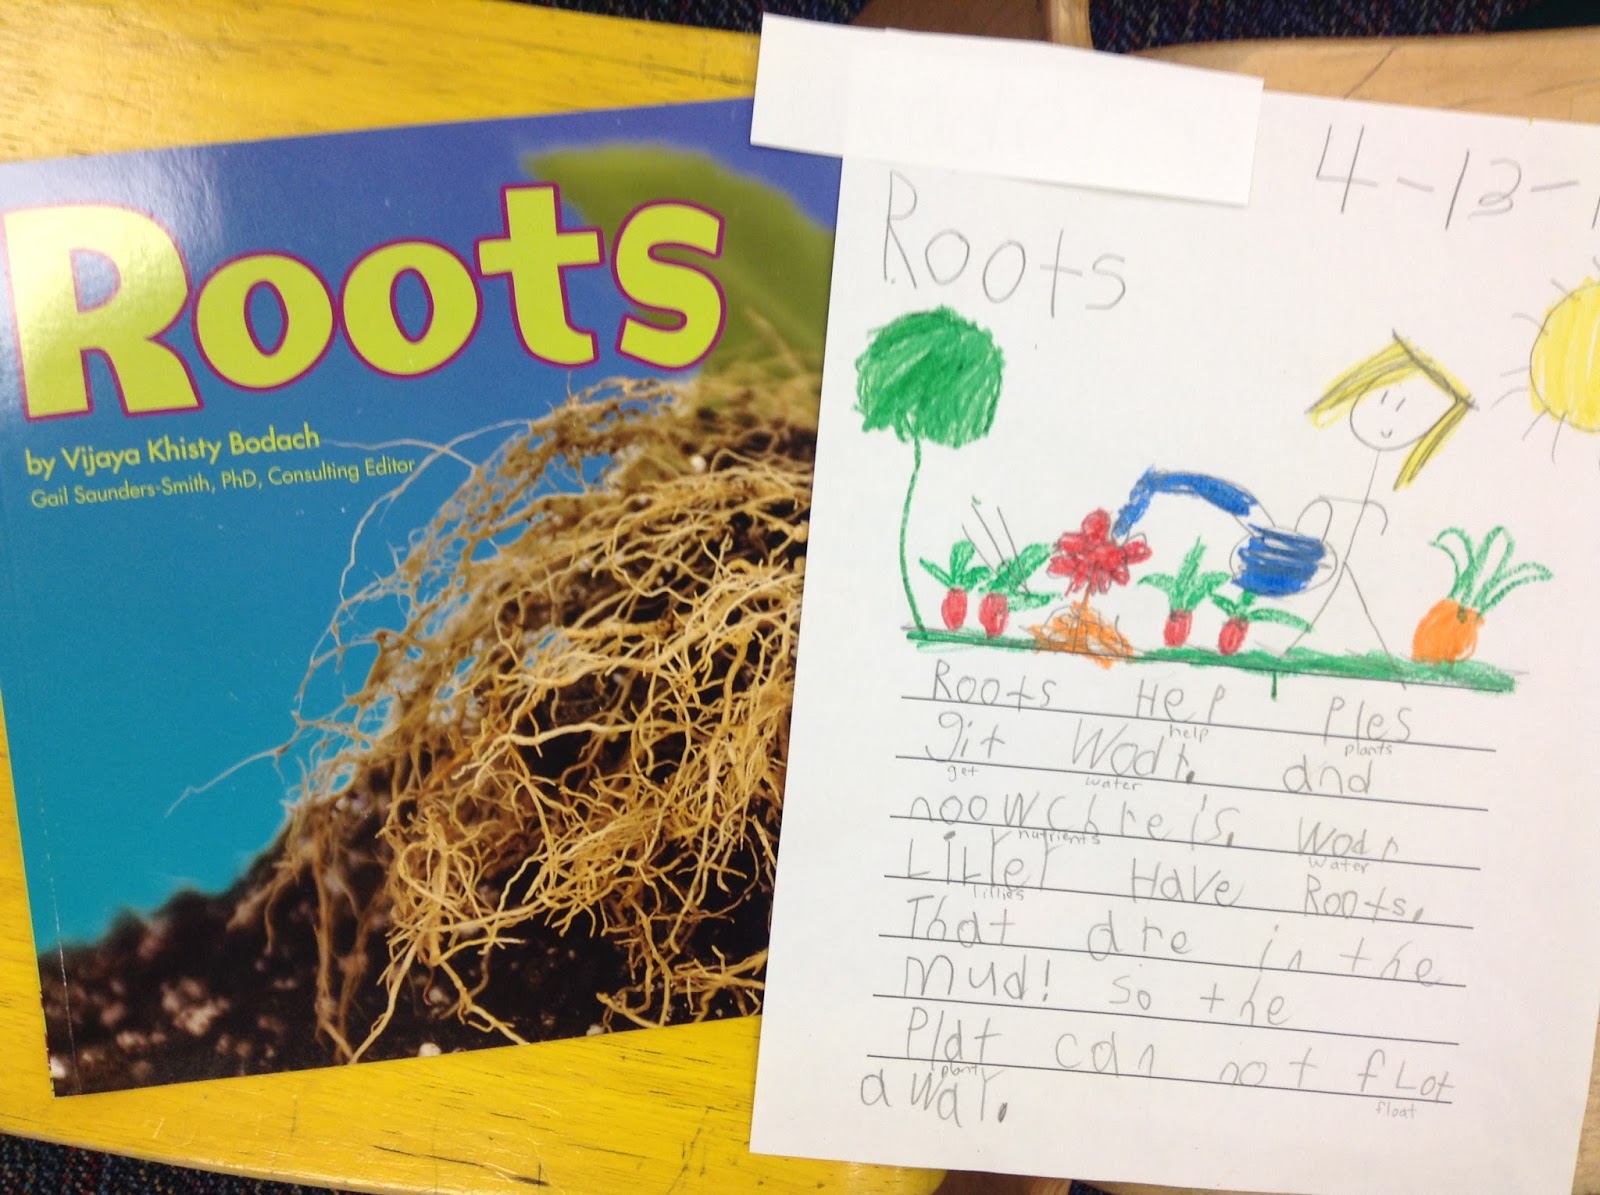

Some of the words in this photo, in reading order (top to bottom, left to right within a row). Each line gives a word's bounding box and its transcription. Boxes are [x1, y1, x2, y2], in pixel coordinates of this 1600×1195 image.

[883, 169, 1127, 318] Roots
[2, 182, 727, 422] Roots
[25, 447, 56, 482] by
[61, 445, 141, 477] Vijaya
[147, 434, 222, 465] Khisty
[229, 420, 320, 456] Bodach
[31, 485, 69, 509] Gail
[221, 467, 262, 491] PhD,
[267, 459, 360, 484] Consulting
[364, 453, 416, 477] Editor
[932, 658, 1057, 712] Roots
[1168, 723, 1210, 743] help
[1344, 738, 1393, 757] plants
[947, 764, 980, 782] get
[1085, 776, 1143, 792] water
[1282, 753, 1374, 795] and
[1019, 829, 1101, 847] nutrients
[1131, 857, 1243, 907] Have
[906, 895, 1016, 948] That
[1258, 923, 1303, 973] in
[1338, 936, 1443, 987] the
[1199, 975, 1291, 1027] the
[1218, 1047, 1319, 1092] not
[1375, 1100, 1417, 1120] float
